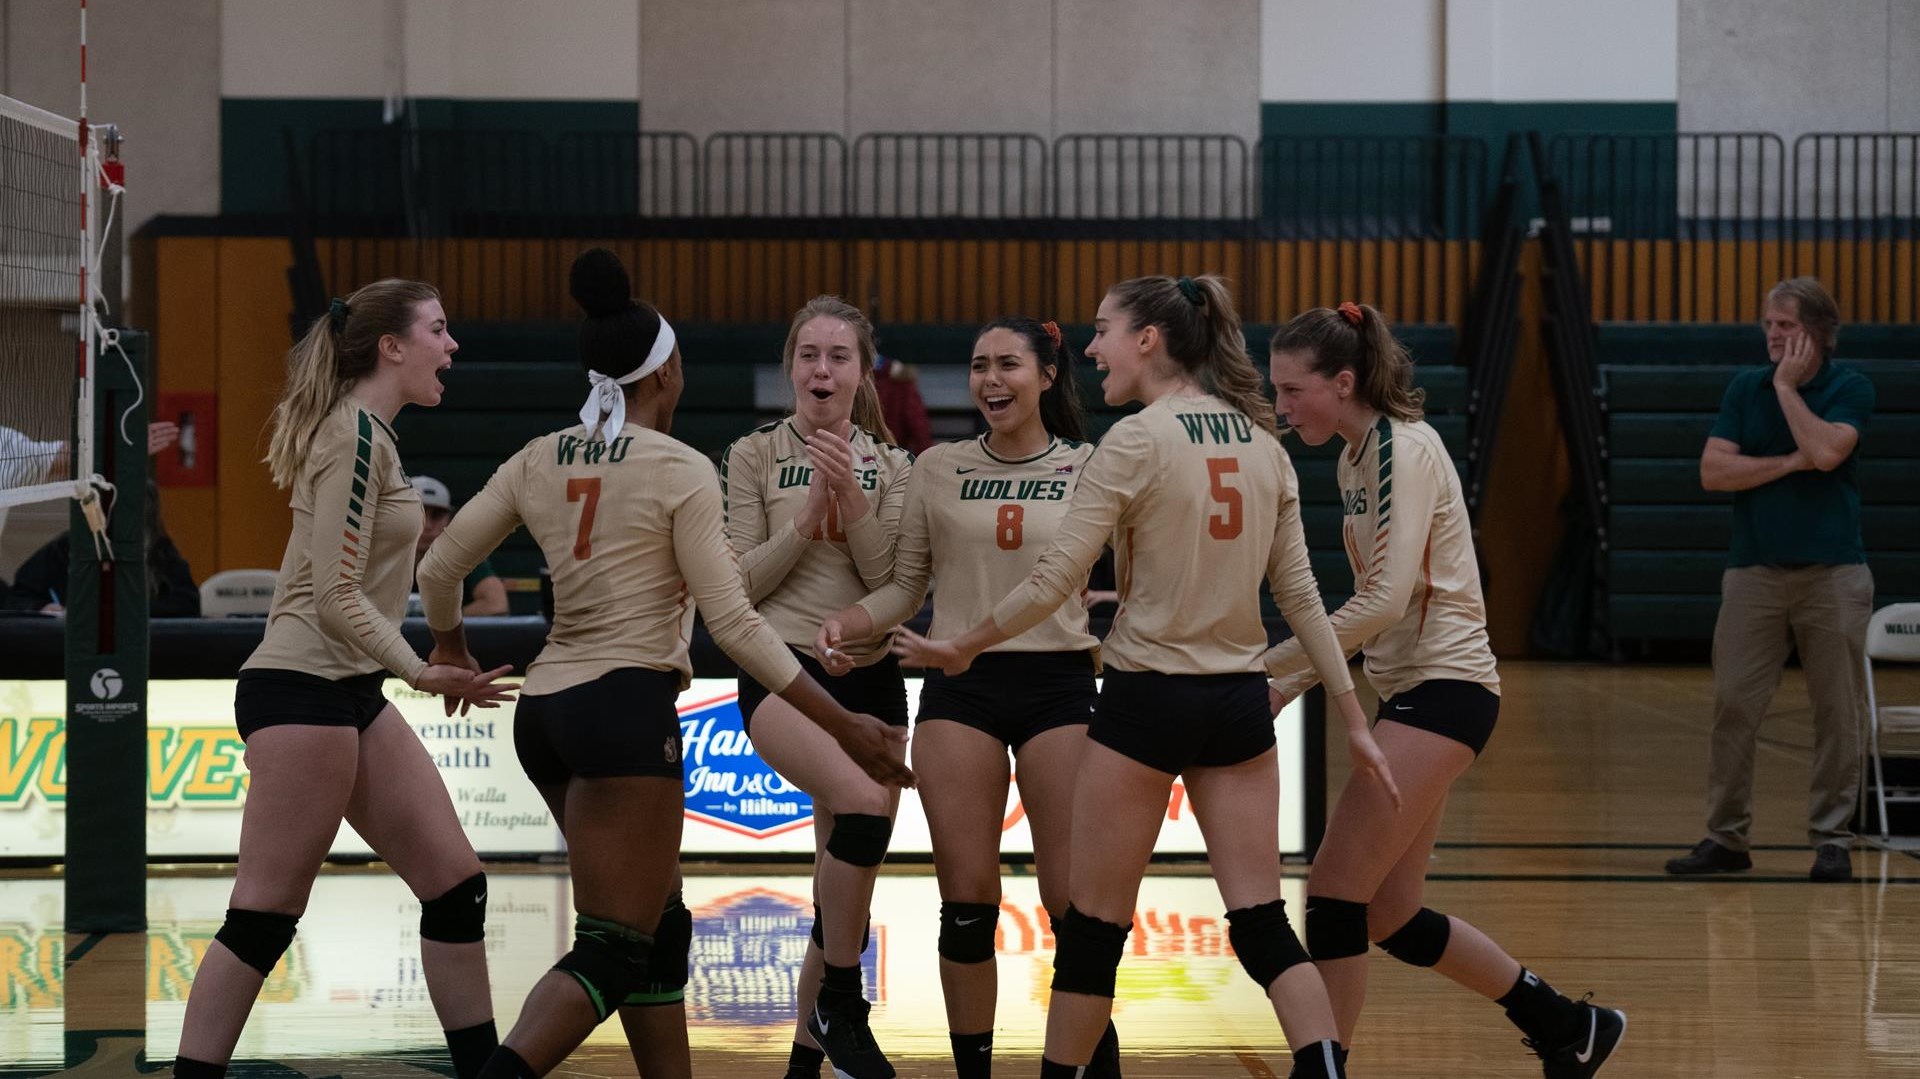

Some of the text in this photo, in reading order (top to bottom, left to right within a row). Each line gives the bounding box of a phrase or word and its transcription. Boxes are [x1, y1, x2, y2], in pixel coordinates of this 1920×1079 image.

[1176, 412, 1252, 444] WWU
[557, 434, 634, 465] WWU
[960, 479, 1067, 500] WOLVES
[1206, 457, 1243, 540] 5
[566, 477, 602, 560] 7
[996, 504, 1024, 551] 8
[420, 718, 496, 739] entist
[437, 746, 490, 768] alth
[457, 787, 507, 803] Walla
[739, 797, 799, 816] Hilton
[474, 811, 549, 830] Hospital
